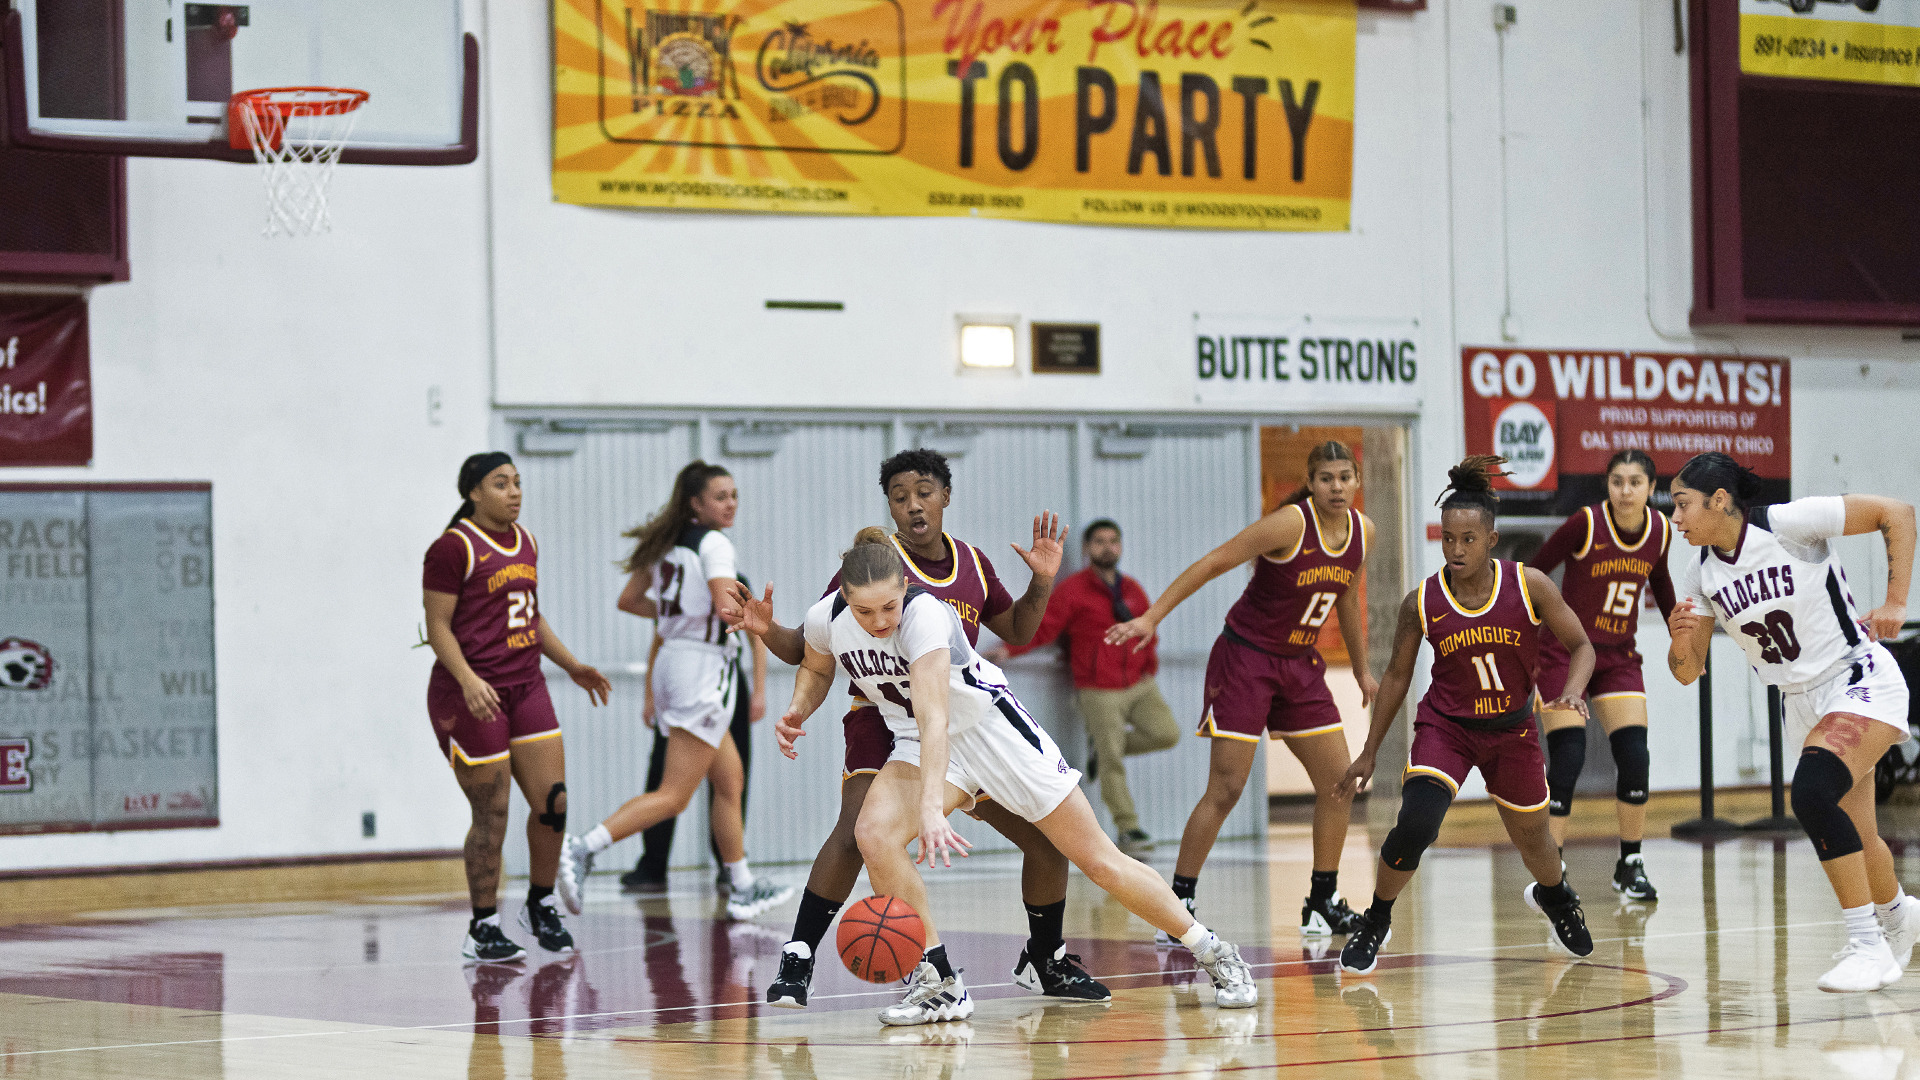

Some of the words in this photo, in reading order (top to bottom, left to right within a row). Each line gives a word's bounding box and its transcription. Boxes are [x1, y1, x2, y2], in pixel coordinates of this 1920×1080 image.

[932, 0, 1061, 78] Your
[1087, 0, 1234, 62] Place
[1844, 41, 1913, 66] Insurance
[632, 98, 740, 118] PIZZA
[948, 60, 1040, 171] TO
[1076, 66, 1321, 183] PARTY
[1082, 197, 1144, 214] FOLLOW
[1149, 201, 1168, 217] US
[1198, 335, 1291, 381] BUTTE
[1299, 338, 1417, 383] STRONG
[1470, 352, 1538, 398] GO
[1550, 354, 1782, 407] WILDCATS!
[0, 381, 47, 414] ics!
[1500, 421, 1545, 445] BAY
[1600, 406, 1649, 426] PROUD
[1651, 408, 1738, 430] SUPPORTERS
[1740, 411, 1757, 430] OF
[1580, 430, 1609, 449] CAL
[1612, 430, 1650, 450] STATE
[1653, 432, 1732, 453] UNIVERSITY
[1734, 435, 1774, 455] CHICO
[1300, 592, 1337, 628] 13
[1603, 581, 1638, 616] 15
[1595, 616, 1629, 635] HILLS
[1440, 626, 1521, 657] DOMINGUEZ
[1471, 652, 1505, 692] 11
[1475, 695, 1511, 715] HILLS
